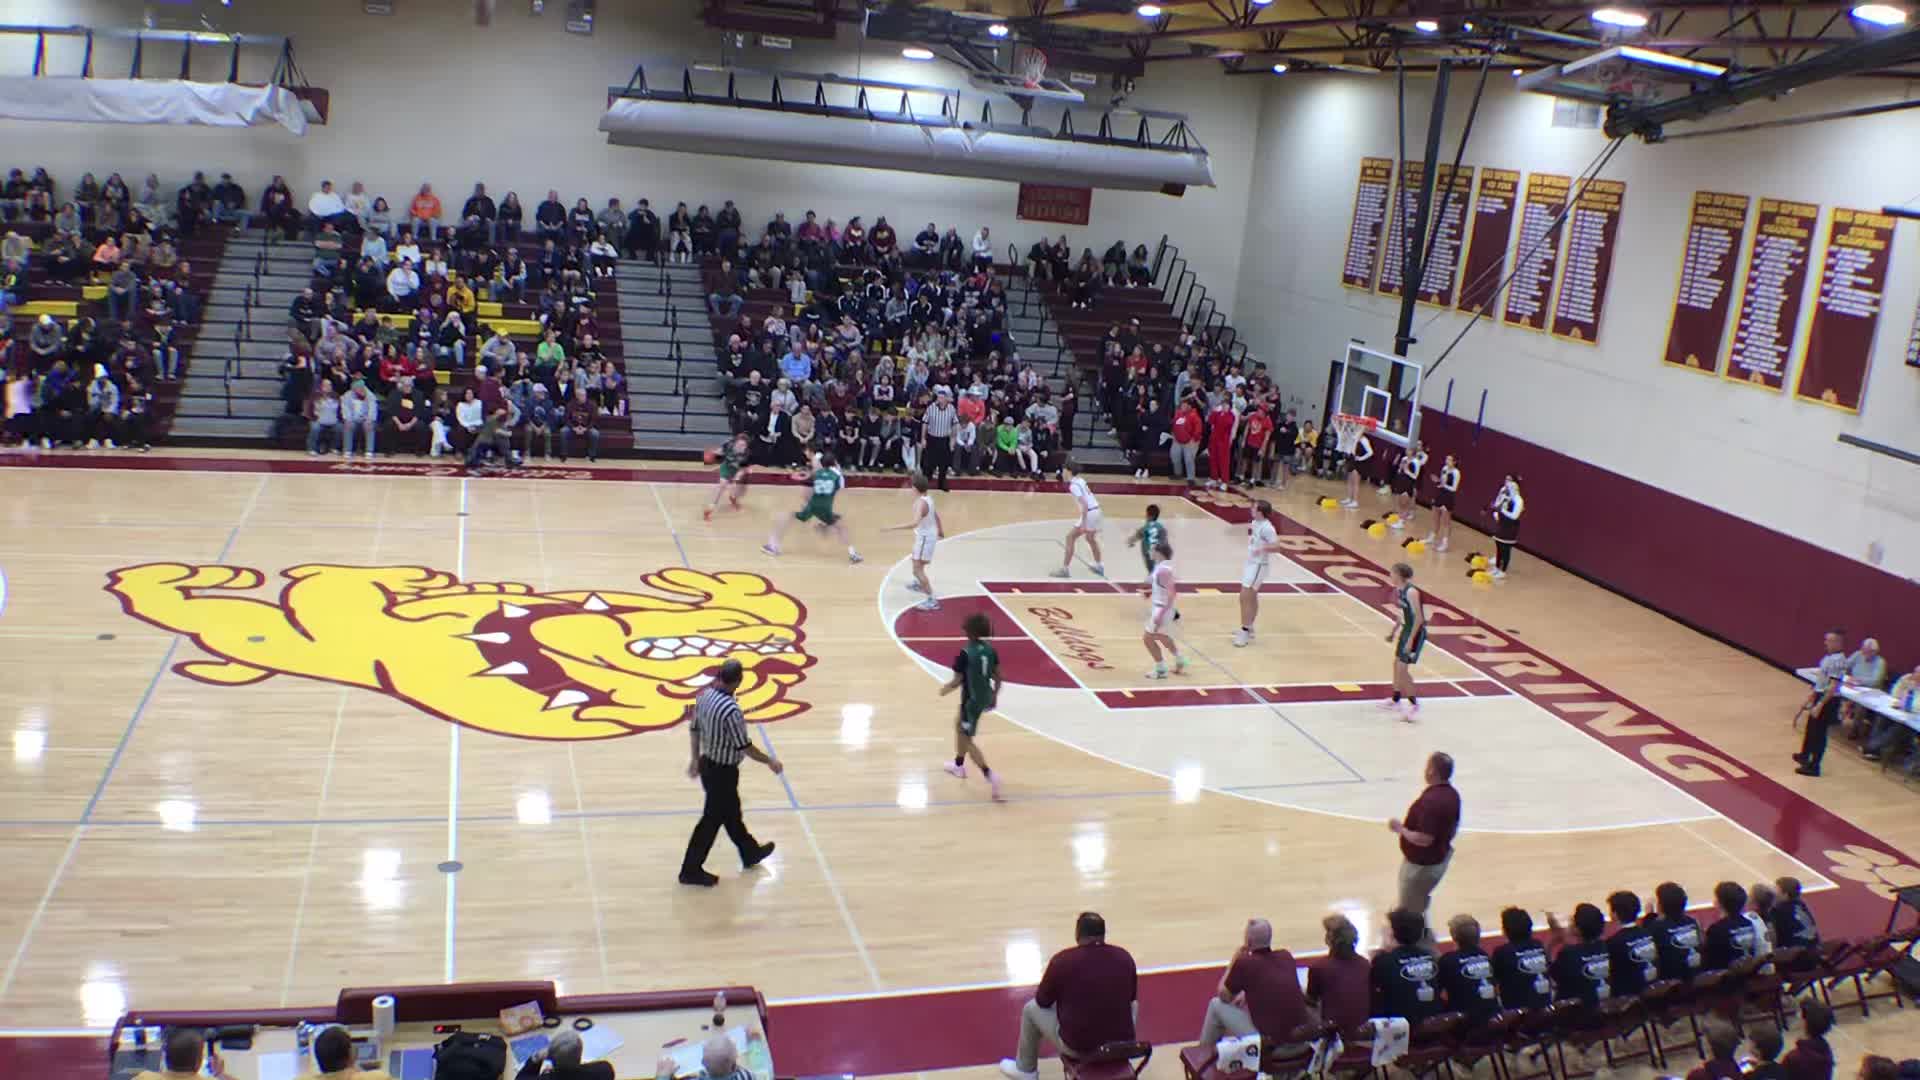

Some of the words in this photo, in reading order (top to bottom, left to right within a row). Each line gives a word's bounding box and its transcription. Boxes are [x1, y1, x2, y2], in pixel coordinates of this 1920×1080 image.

[1147, 527, 1159, 545] 2
[1276, 534, 1397, 588] BIG
[1026, 607, 1117, 672] Bulldogs
[980, 655, 990, 677] 1
